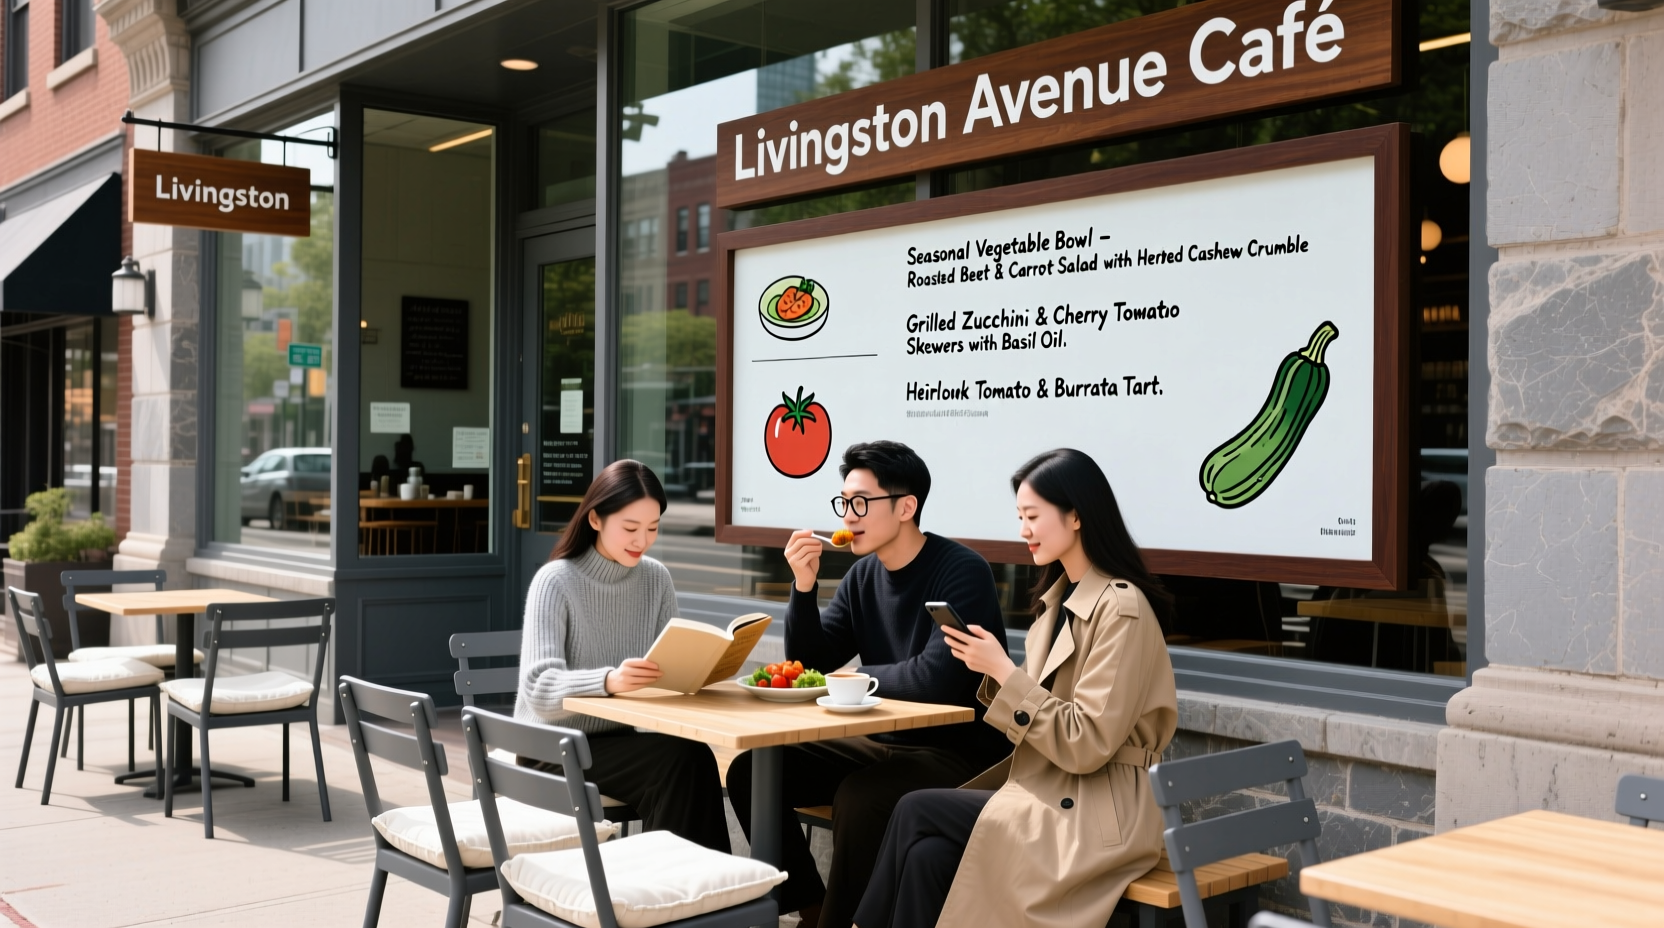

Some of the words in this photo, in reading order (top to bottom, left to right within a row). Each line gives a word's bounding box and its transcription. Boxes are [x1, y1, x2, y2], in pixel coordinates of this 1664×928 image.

[734, 101, 947, 181] Livingston
[962, 51, 1168, 135] Avenue
[1189, 0, 1345, 85] Café
[156, 174, 289, 213] Livingston
[906, 240, 971, 266] Seasonal
[975, 231, 1050, 263] Vegetable
[1054, 226, 1094, 251] Bowl
[960, 263, 991, 283] Beet
[994, 262, 1004, 280] &
[1008, 259, 1055, 279] Carrot
[1057, 252, 1098, 275] Salad
[1103, 249, 1133, 270] with
[1187, 241, 1244, 263] Cashew
[1247, 233, 1309, 258] Crumble
[906, 310, 957, 334] Grilled
[961, 307, 1030, 331] Zucchini
[1034, 305, 1048, 327] &
[1052, 303, 1109, 332] Cherry
[906, 336, 965, 356] Skewers
[968, 333, 998, 352] with
[1001, 331, 1037, 351] Basil
[1040, 328, 1067, 349] Oil.
[974, 379, 1032, 400] Tomato
[1036, 377, 1049, 399] &
[1054, 377, 1119, 398] Burrata
[1122, 375, 1163, 397] Tart.
